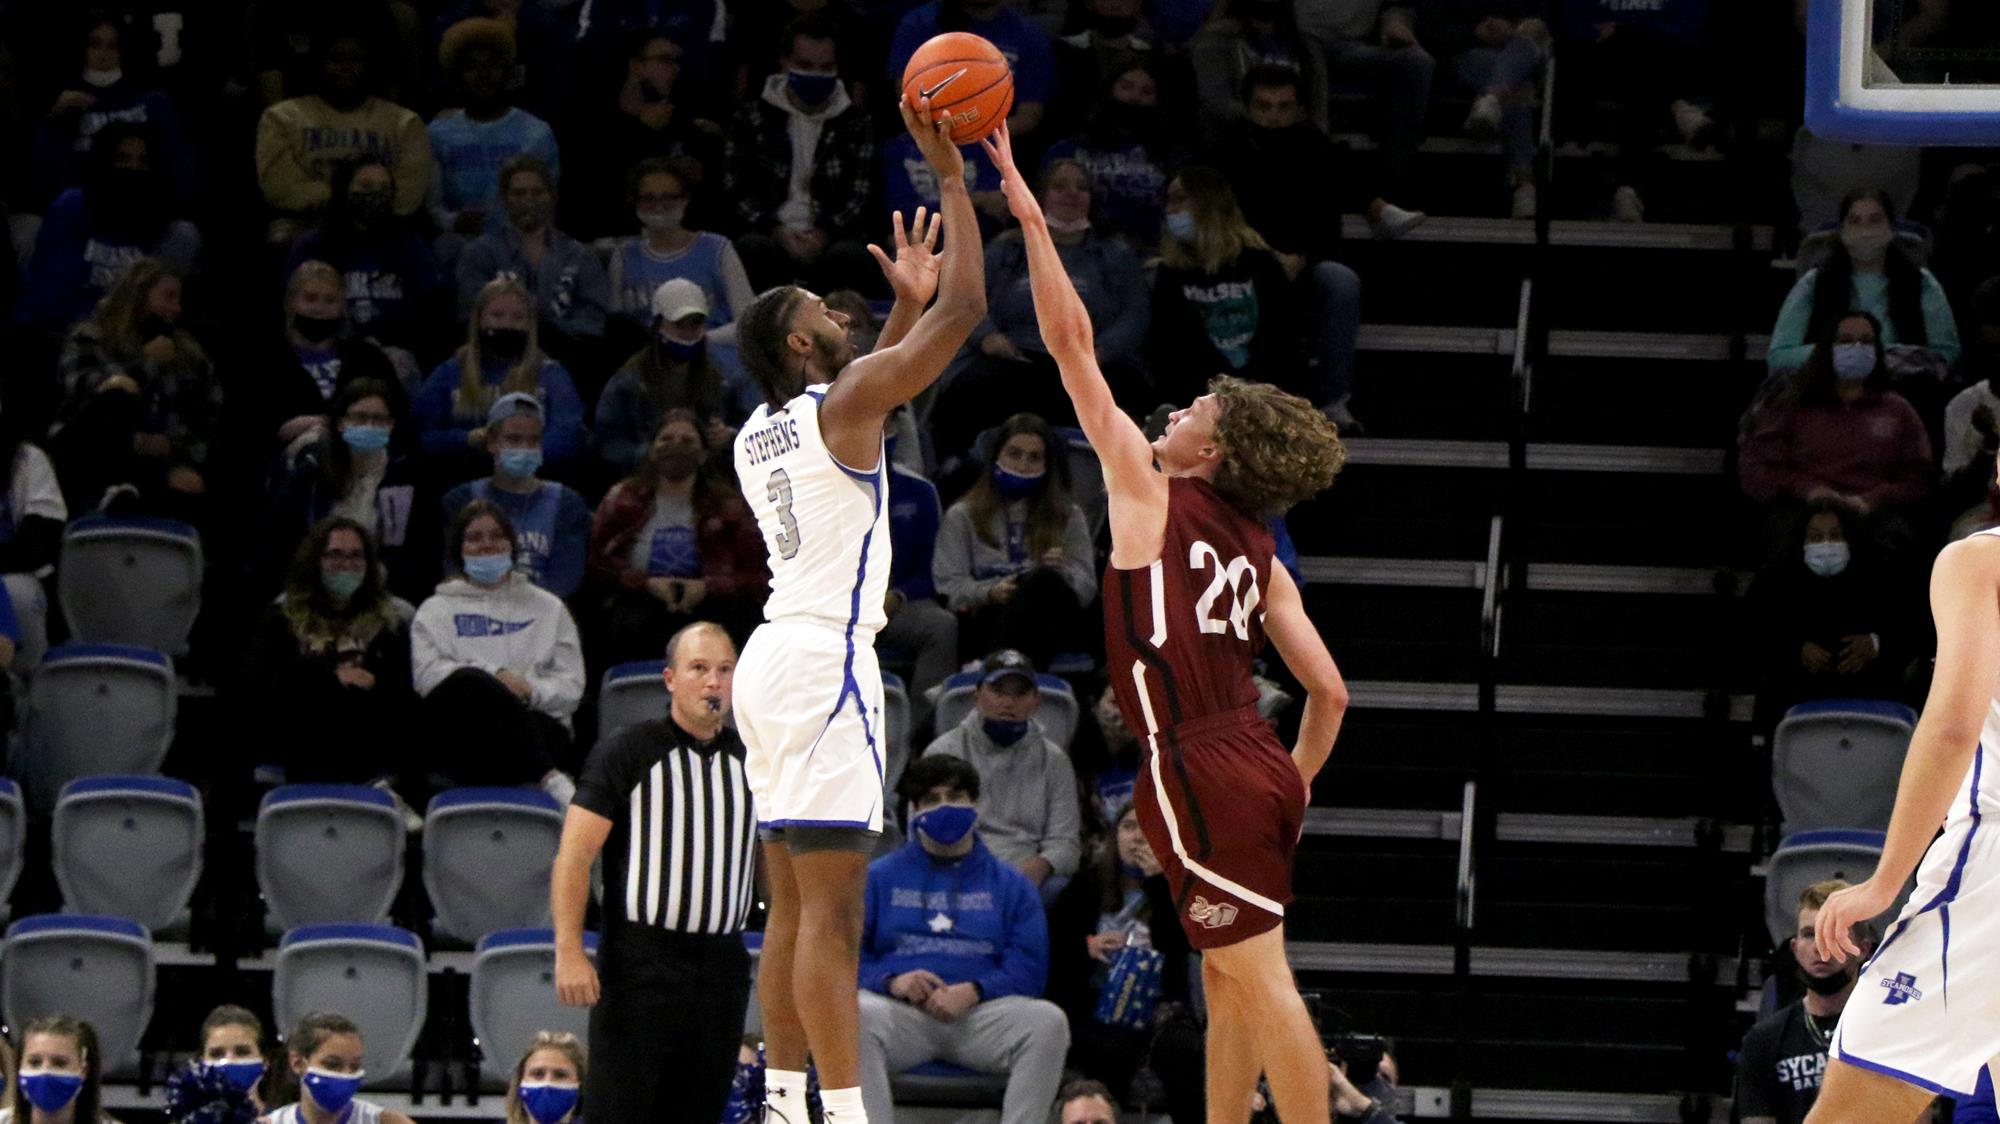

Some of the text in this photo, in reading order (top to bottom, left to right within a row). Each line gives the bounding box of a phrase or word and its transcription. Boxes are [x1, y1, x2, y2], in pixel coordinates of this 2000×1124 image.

[744, 418, 800, 466] STEPHENS
[766, 467, 801, 561] 3
[1190, 540, 1260, 641] 20
[1881, 979, 1921, 1000] SYCAMORES
